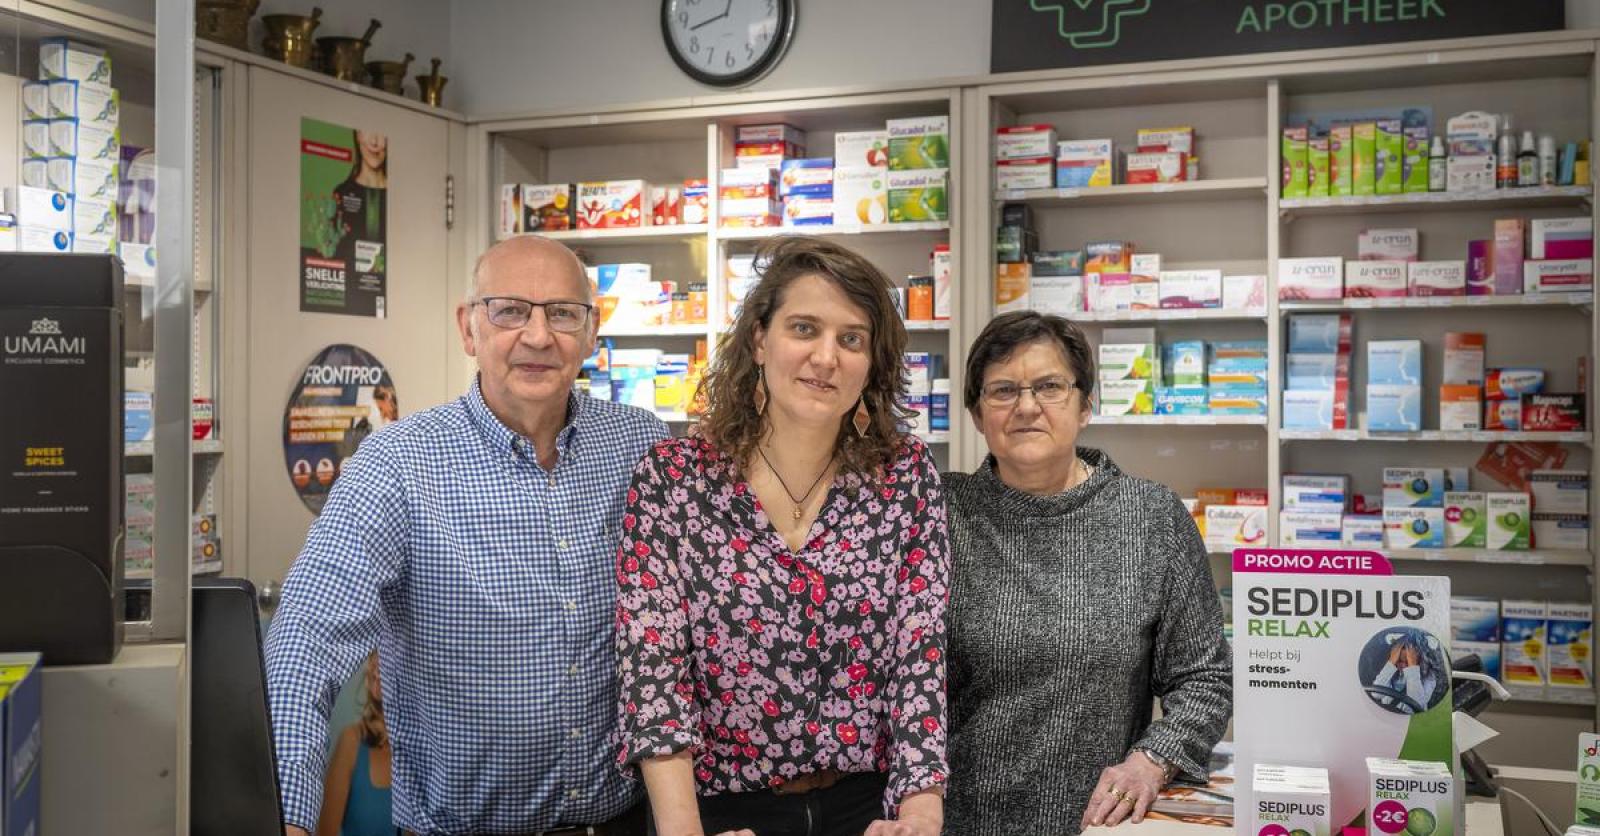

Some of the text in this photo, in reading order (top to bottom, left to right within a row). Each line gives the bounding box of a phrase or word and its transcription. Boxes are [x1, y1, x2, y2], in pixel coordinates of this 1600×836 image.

[680, 11, 689, 29] 9
[1235, 0, 1446, 34] APOTHEEK
[690, 35, 699, 54] 8
[745, 43, 754, 60] 5
[706, 47, 714, 64] 7
[725, 50, 736, 67] 6
[305, 267, 345, 282] SNELLE
[4, 336, 86, 354] UMAMI
[304, 365, 382, 385] FRONTPRO
[25, 447, 65, 457] SWEET
[24, 457, 65, 467] SPICES
[1244, 554, 1373, 570] PROMO ACTIE
[1247, 586, 1425, 620] SEDIPLUS
[1248, 619, 1330, 639] RELAX
[1249, 648, 1301, 663] Helpt bij
[1248, 663, 1291, 674] stress-
[1248, 678, 1317, 690] momenten
[1375, 777, 1447, 794] SEDIPLUS
[1375, 790, 1409, 800] RELAX
[1258, 800, 1325, 816] SEDIPLUS
[1258, 813, 1290, 822] RELAX
[1375, 810, 1405, 823] -2€
